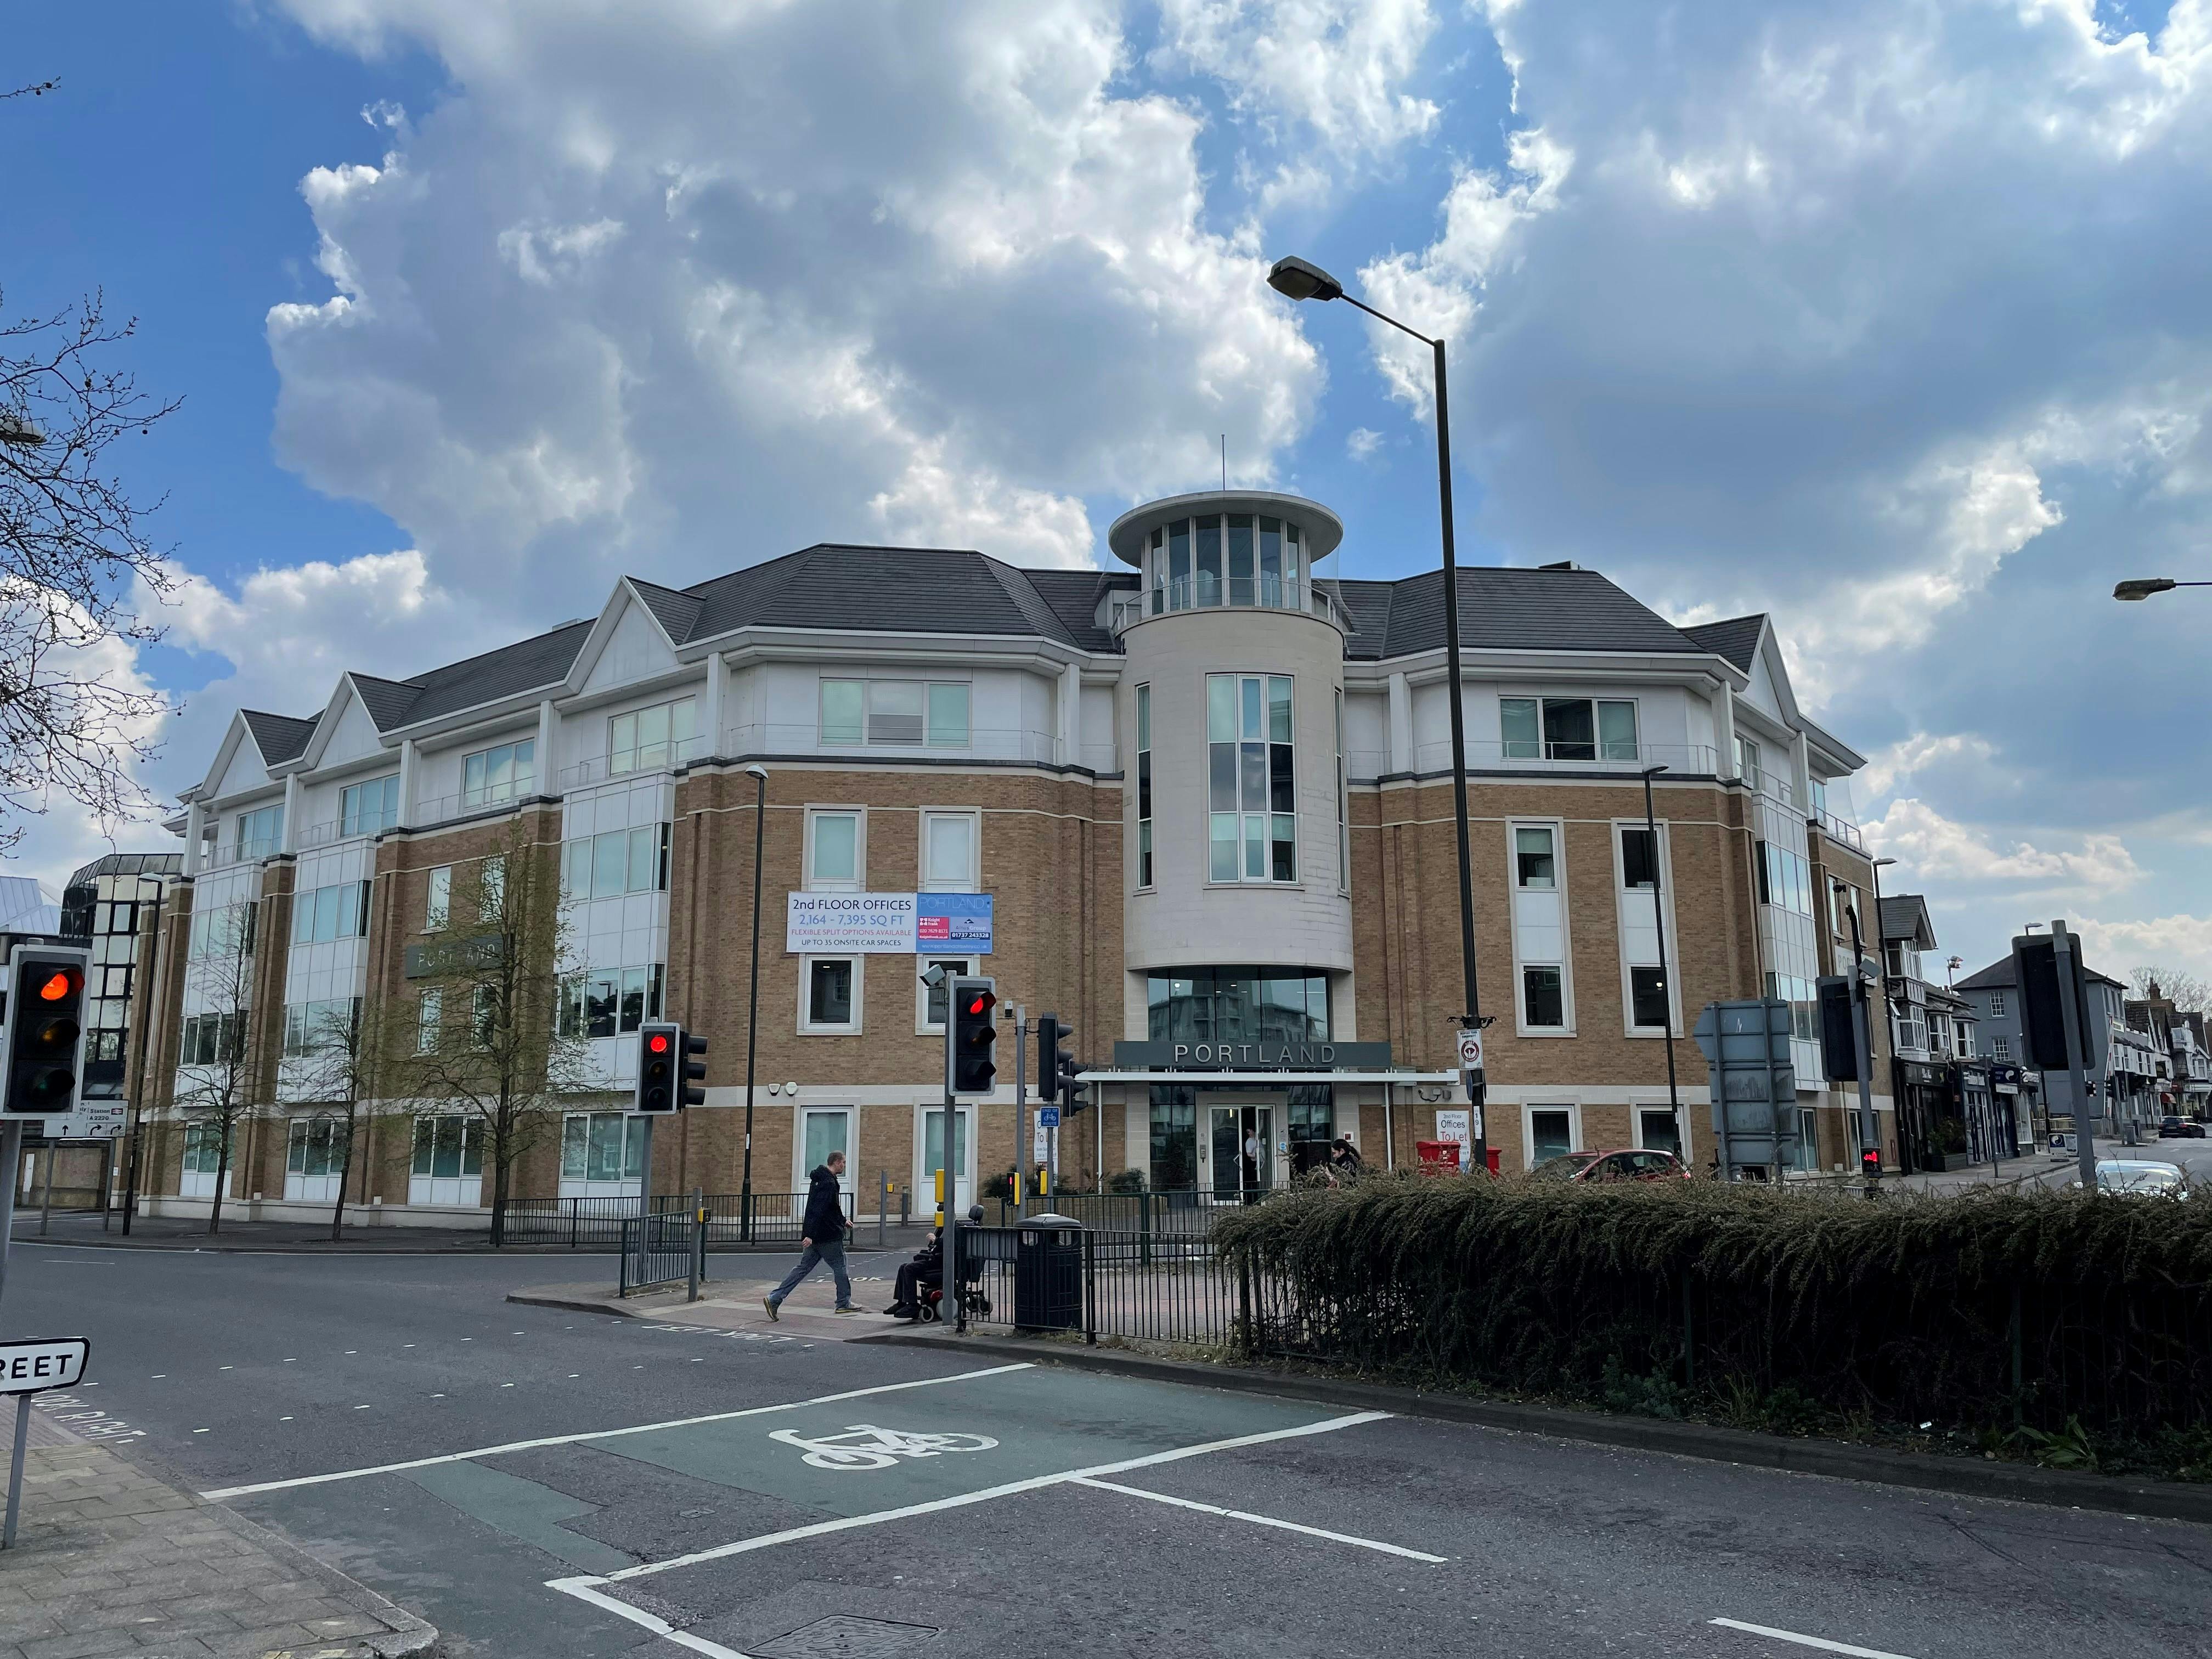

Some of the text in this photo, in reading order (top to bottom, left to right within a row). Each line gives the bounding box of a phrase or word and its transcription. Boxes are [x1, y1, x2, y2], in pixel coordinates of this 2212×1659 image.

[793, 899, 911, 910] 2nd FLOOR OFFICES
[799, 915, 826, 926] 2,164
[838, 915, 866, 926] 7,395
[870, 915, 887, 927] SQ
[891, 915, 905, 925] FT
[419, 944, 495, 968] PORTAND
[1174, 1044, 1335, 1063] PORTLAND
[1441, 1120, 1465, 1128] Offices
[1037, 1132, 1044, 1142] To
[1440, 1131, 1468, 1141] To Let
